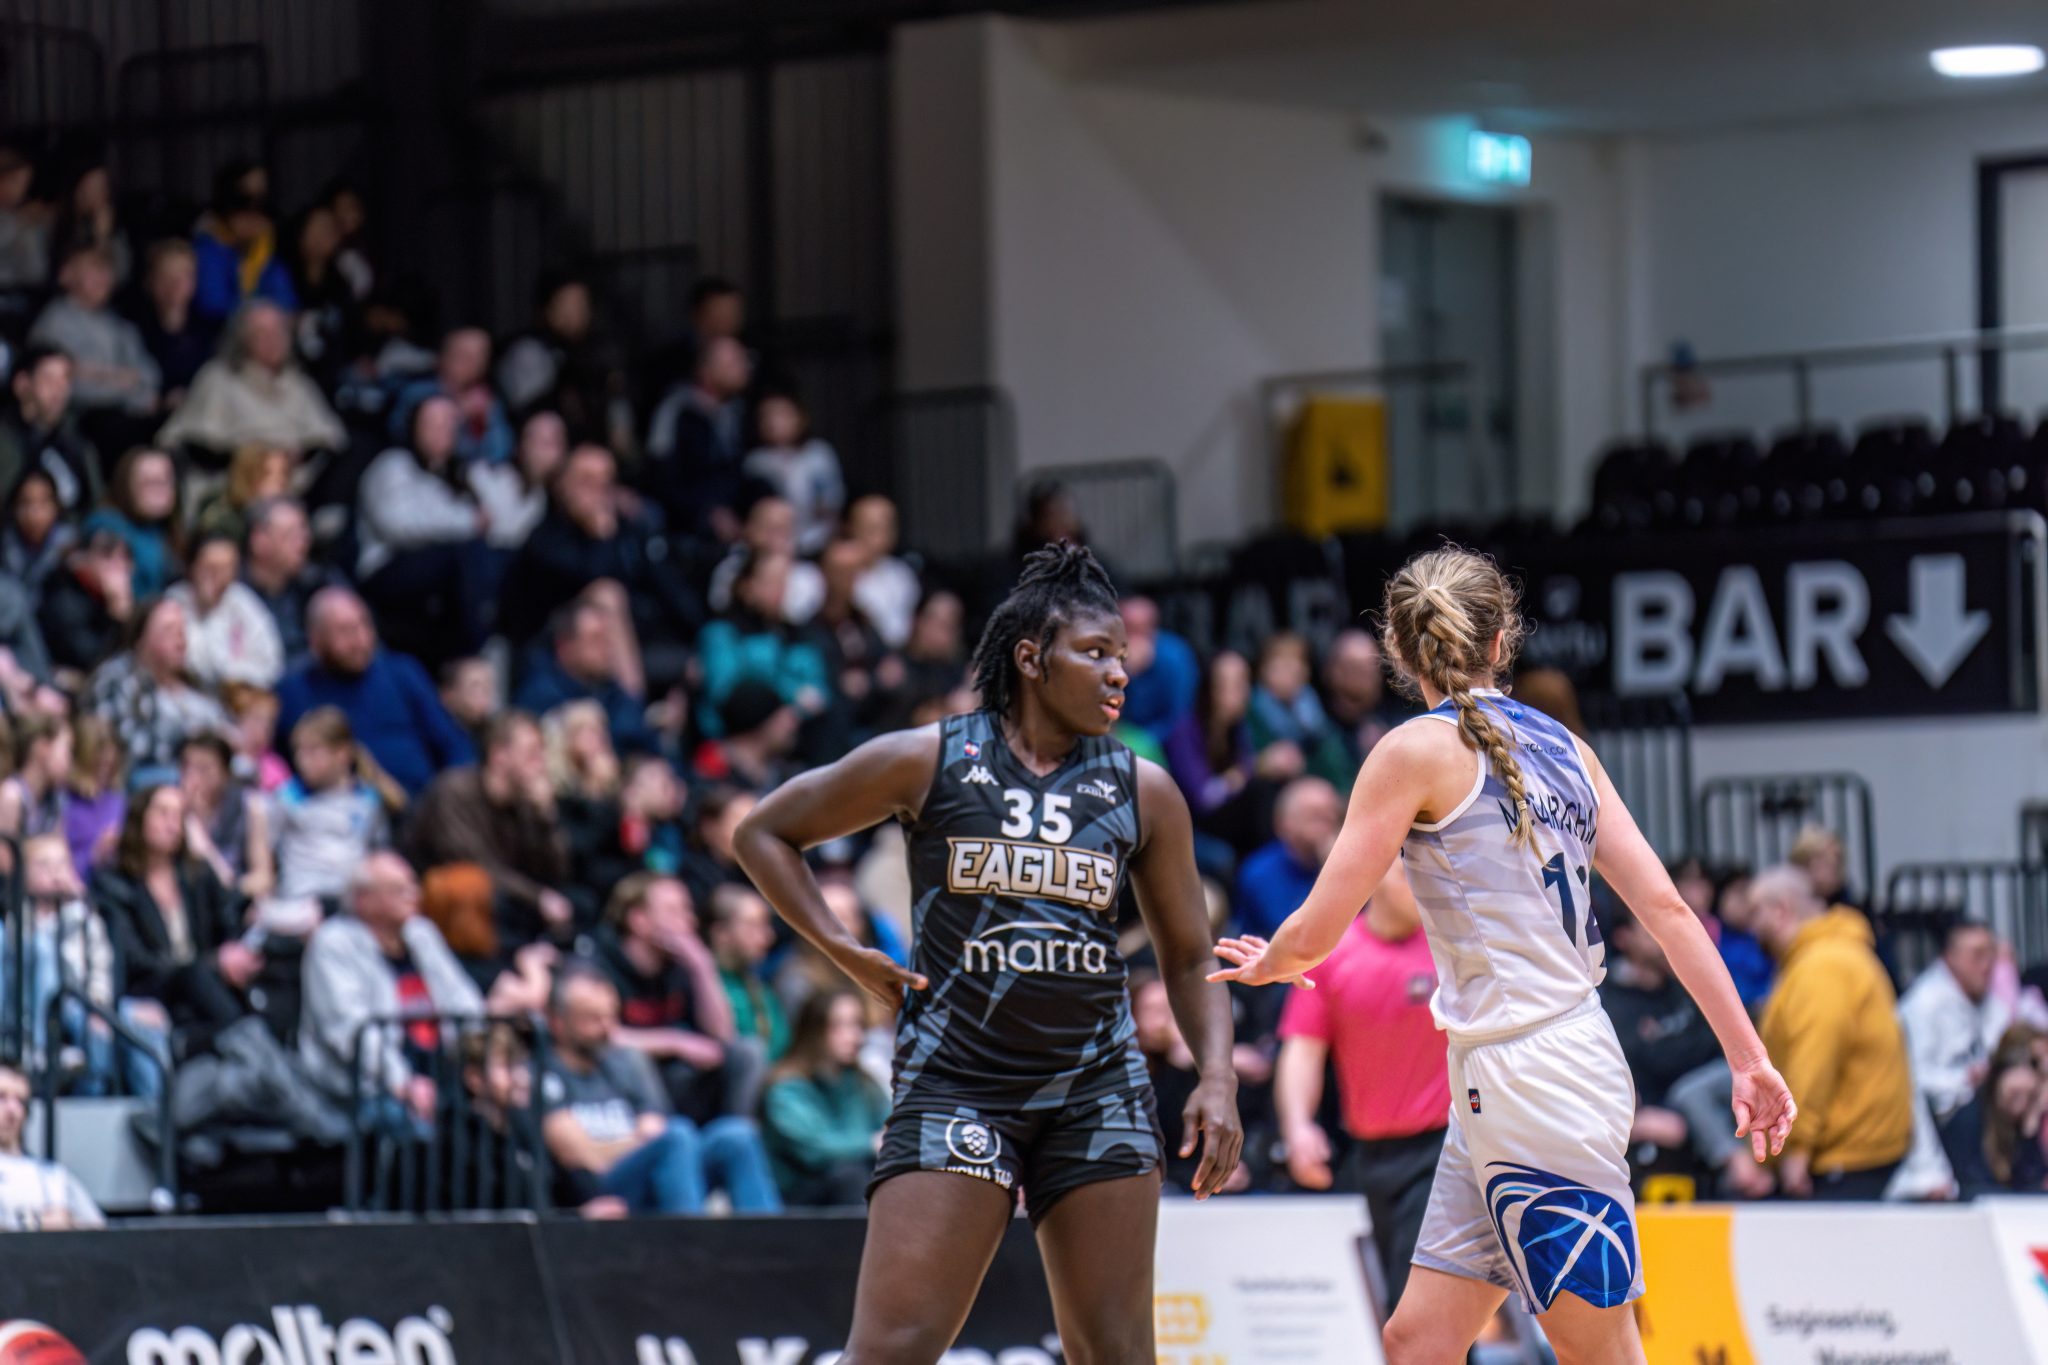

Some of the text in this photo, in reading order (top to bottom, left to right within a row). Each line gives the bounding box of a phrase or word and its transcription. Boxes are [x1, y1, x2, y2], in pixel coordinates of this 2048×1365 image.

[1611, 560, 1870, 695] BAR
[1001, 788, 1073, 844] 35
[951, 842, 1117, 908] EAGLES
[963, 938, 1108, 974] marra
